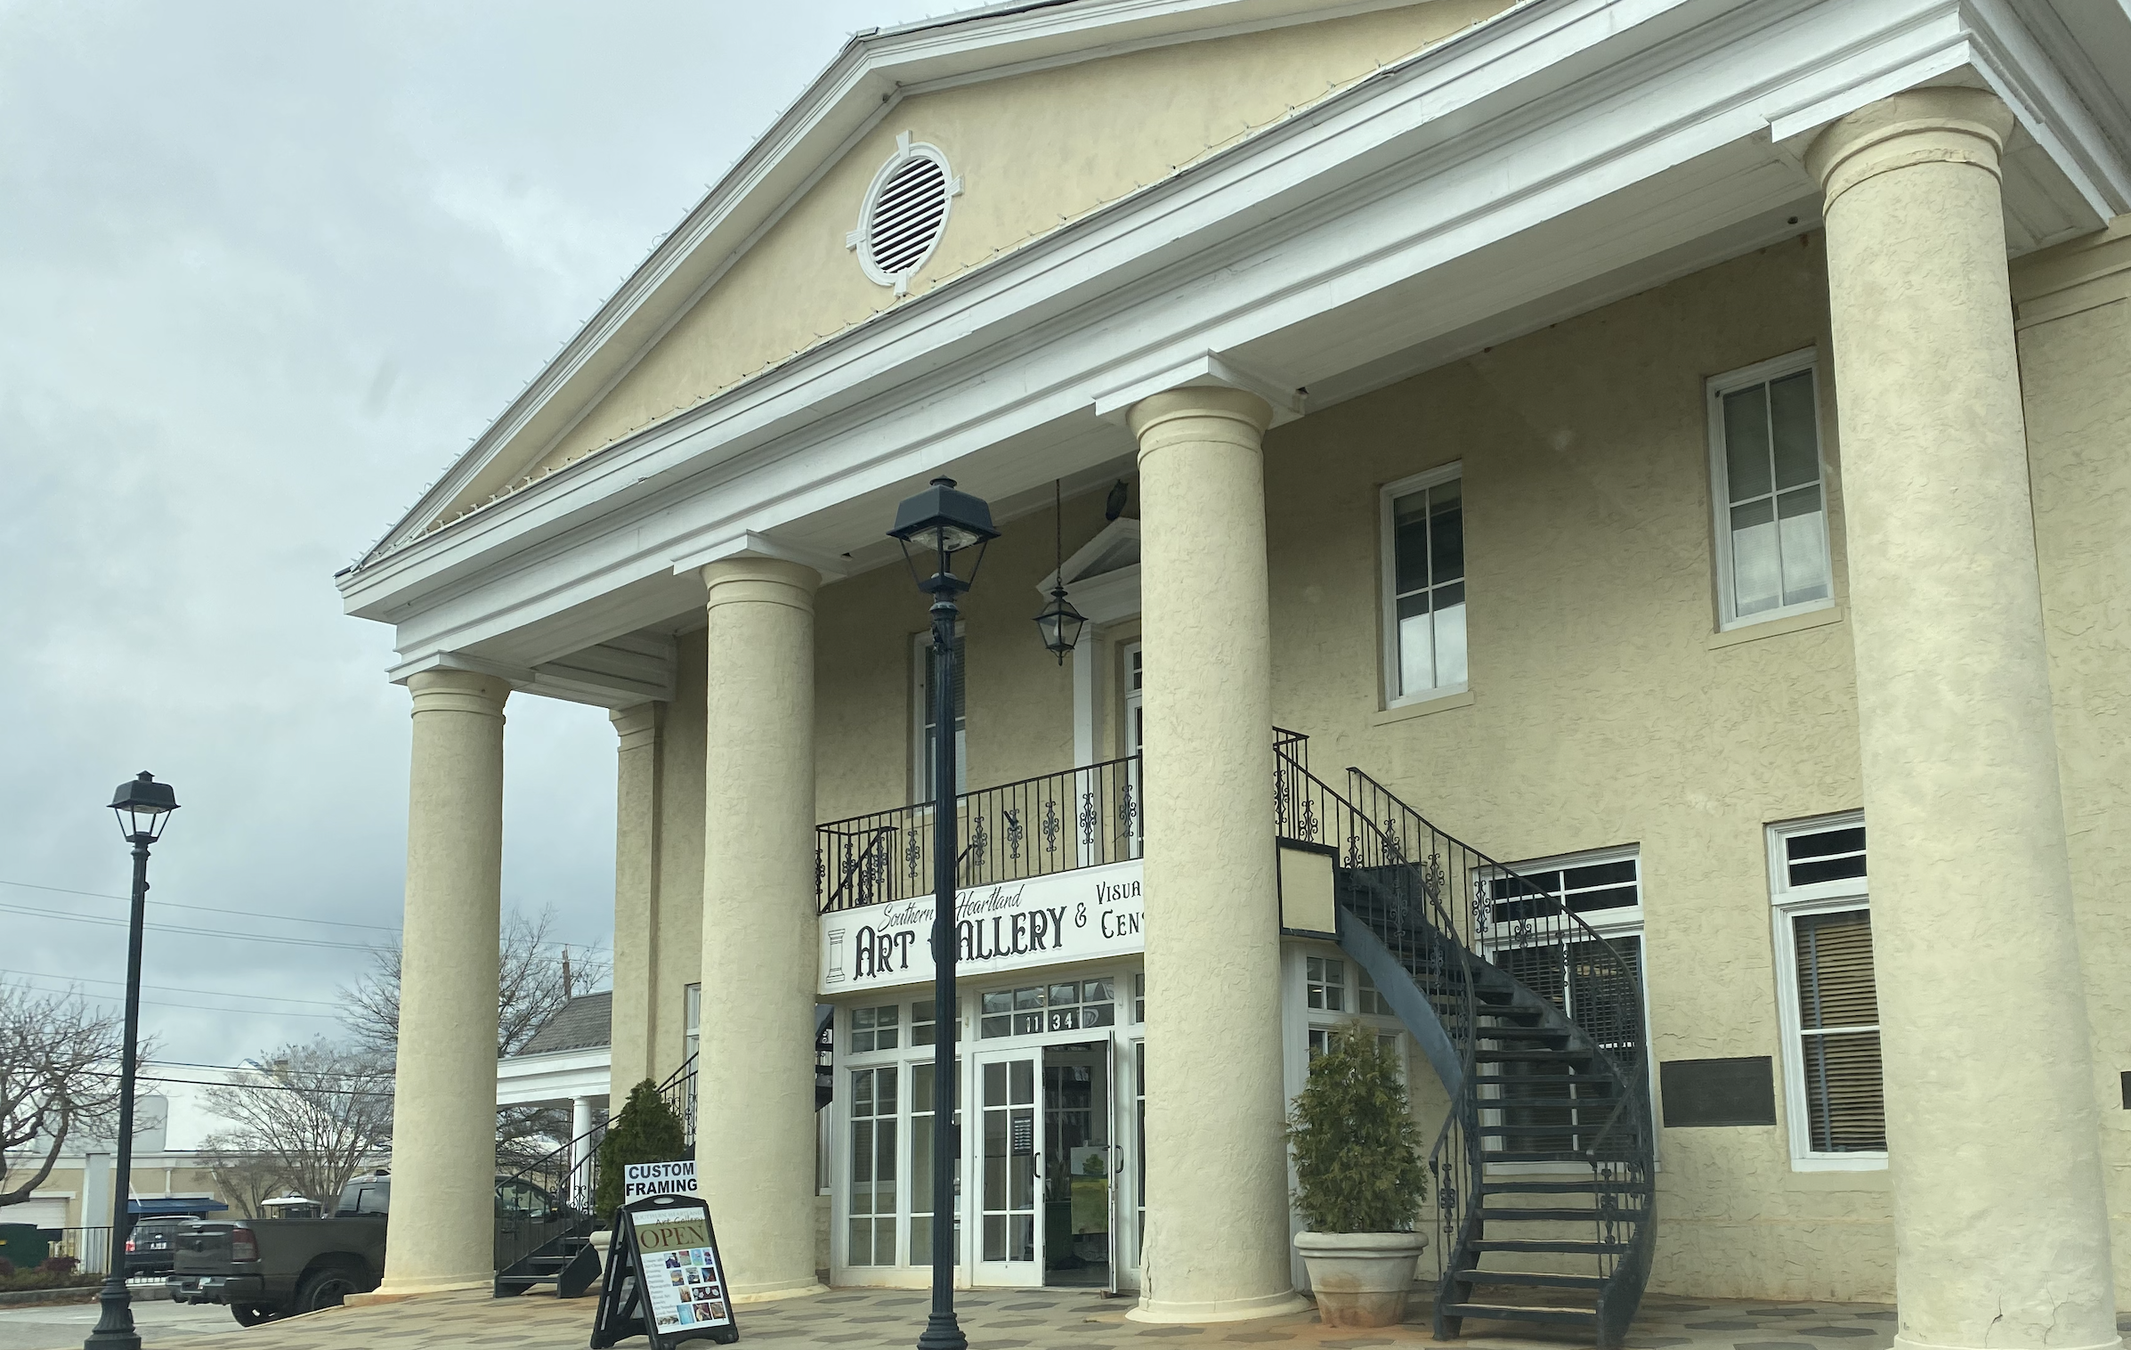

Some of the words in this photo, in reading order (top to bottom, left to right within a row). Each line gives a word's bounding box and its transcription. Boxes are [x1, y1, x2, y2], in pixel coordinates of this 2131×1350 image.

[877, 902, 935, 932] Southern
[955, 884, 1025, 922] Heartland
[1075, 902, 1087, 928] &
[1101, 909, 1145, 939] CEN
[628, 1162, 694, 1180] CUSTOM
[626, 1179, 697, 1196] FRAMING
[655, 1217, 671, 1226] Art
[640, 1225, 705, 1249] OPEN
